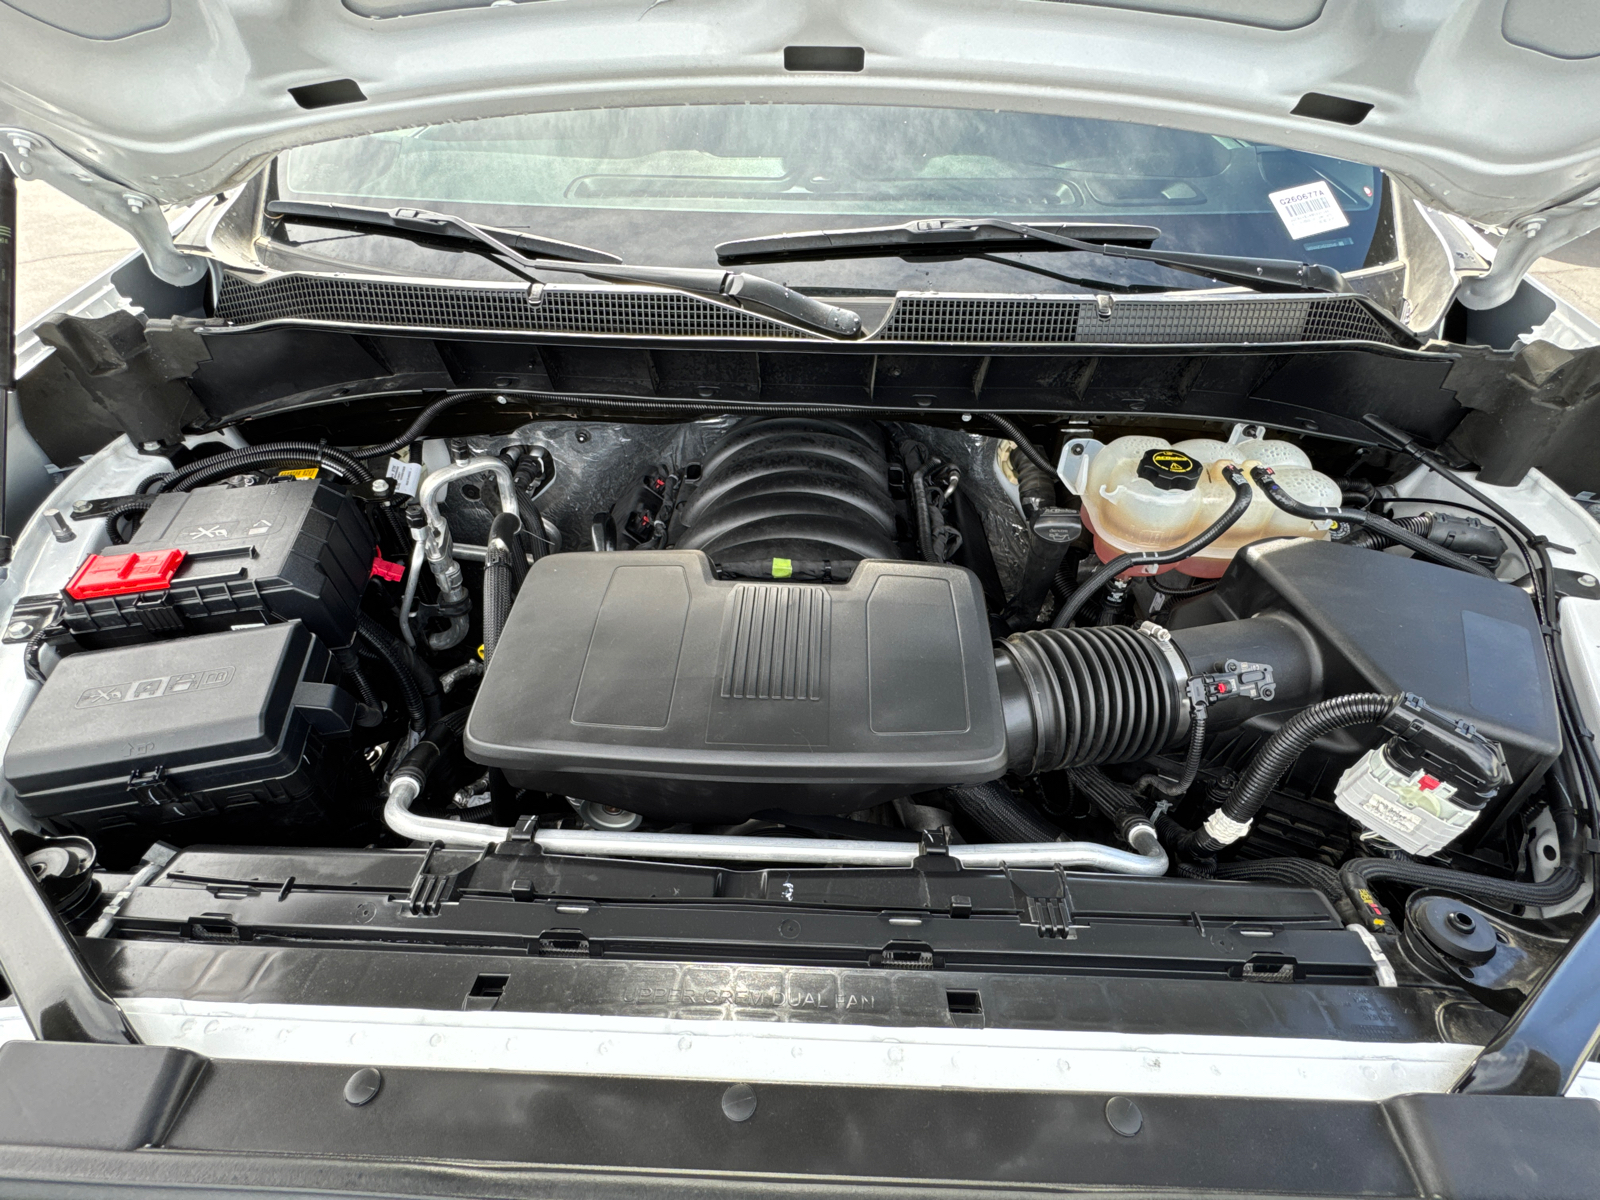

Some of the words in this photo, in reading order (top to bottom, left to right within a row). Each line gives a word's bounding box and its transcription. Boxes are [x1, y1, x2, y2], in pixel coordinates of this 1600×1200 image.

[622, 987, 696, 1004] UPPER
[773, 991, 828, 1008] DUAL
[835, 993, 875, 1010] FAN
